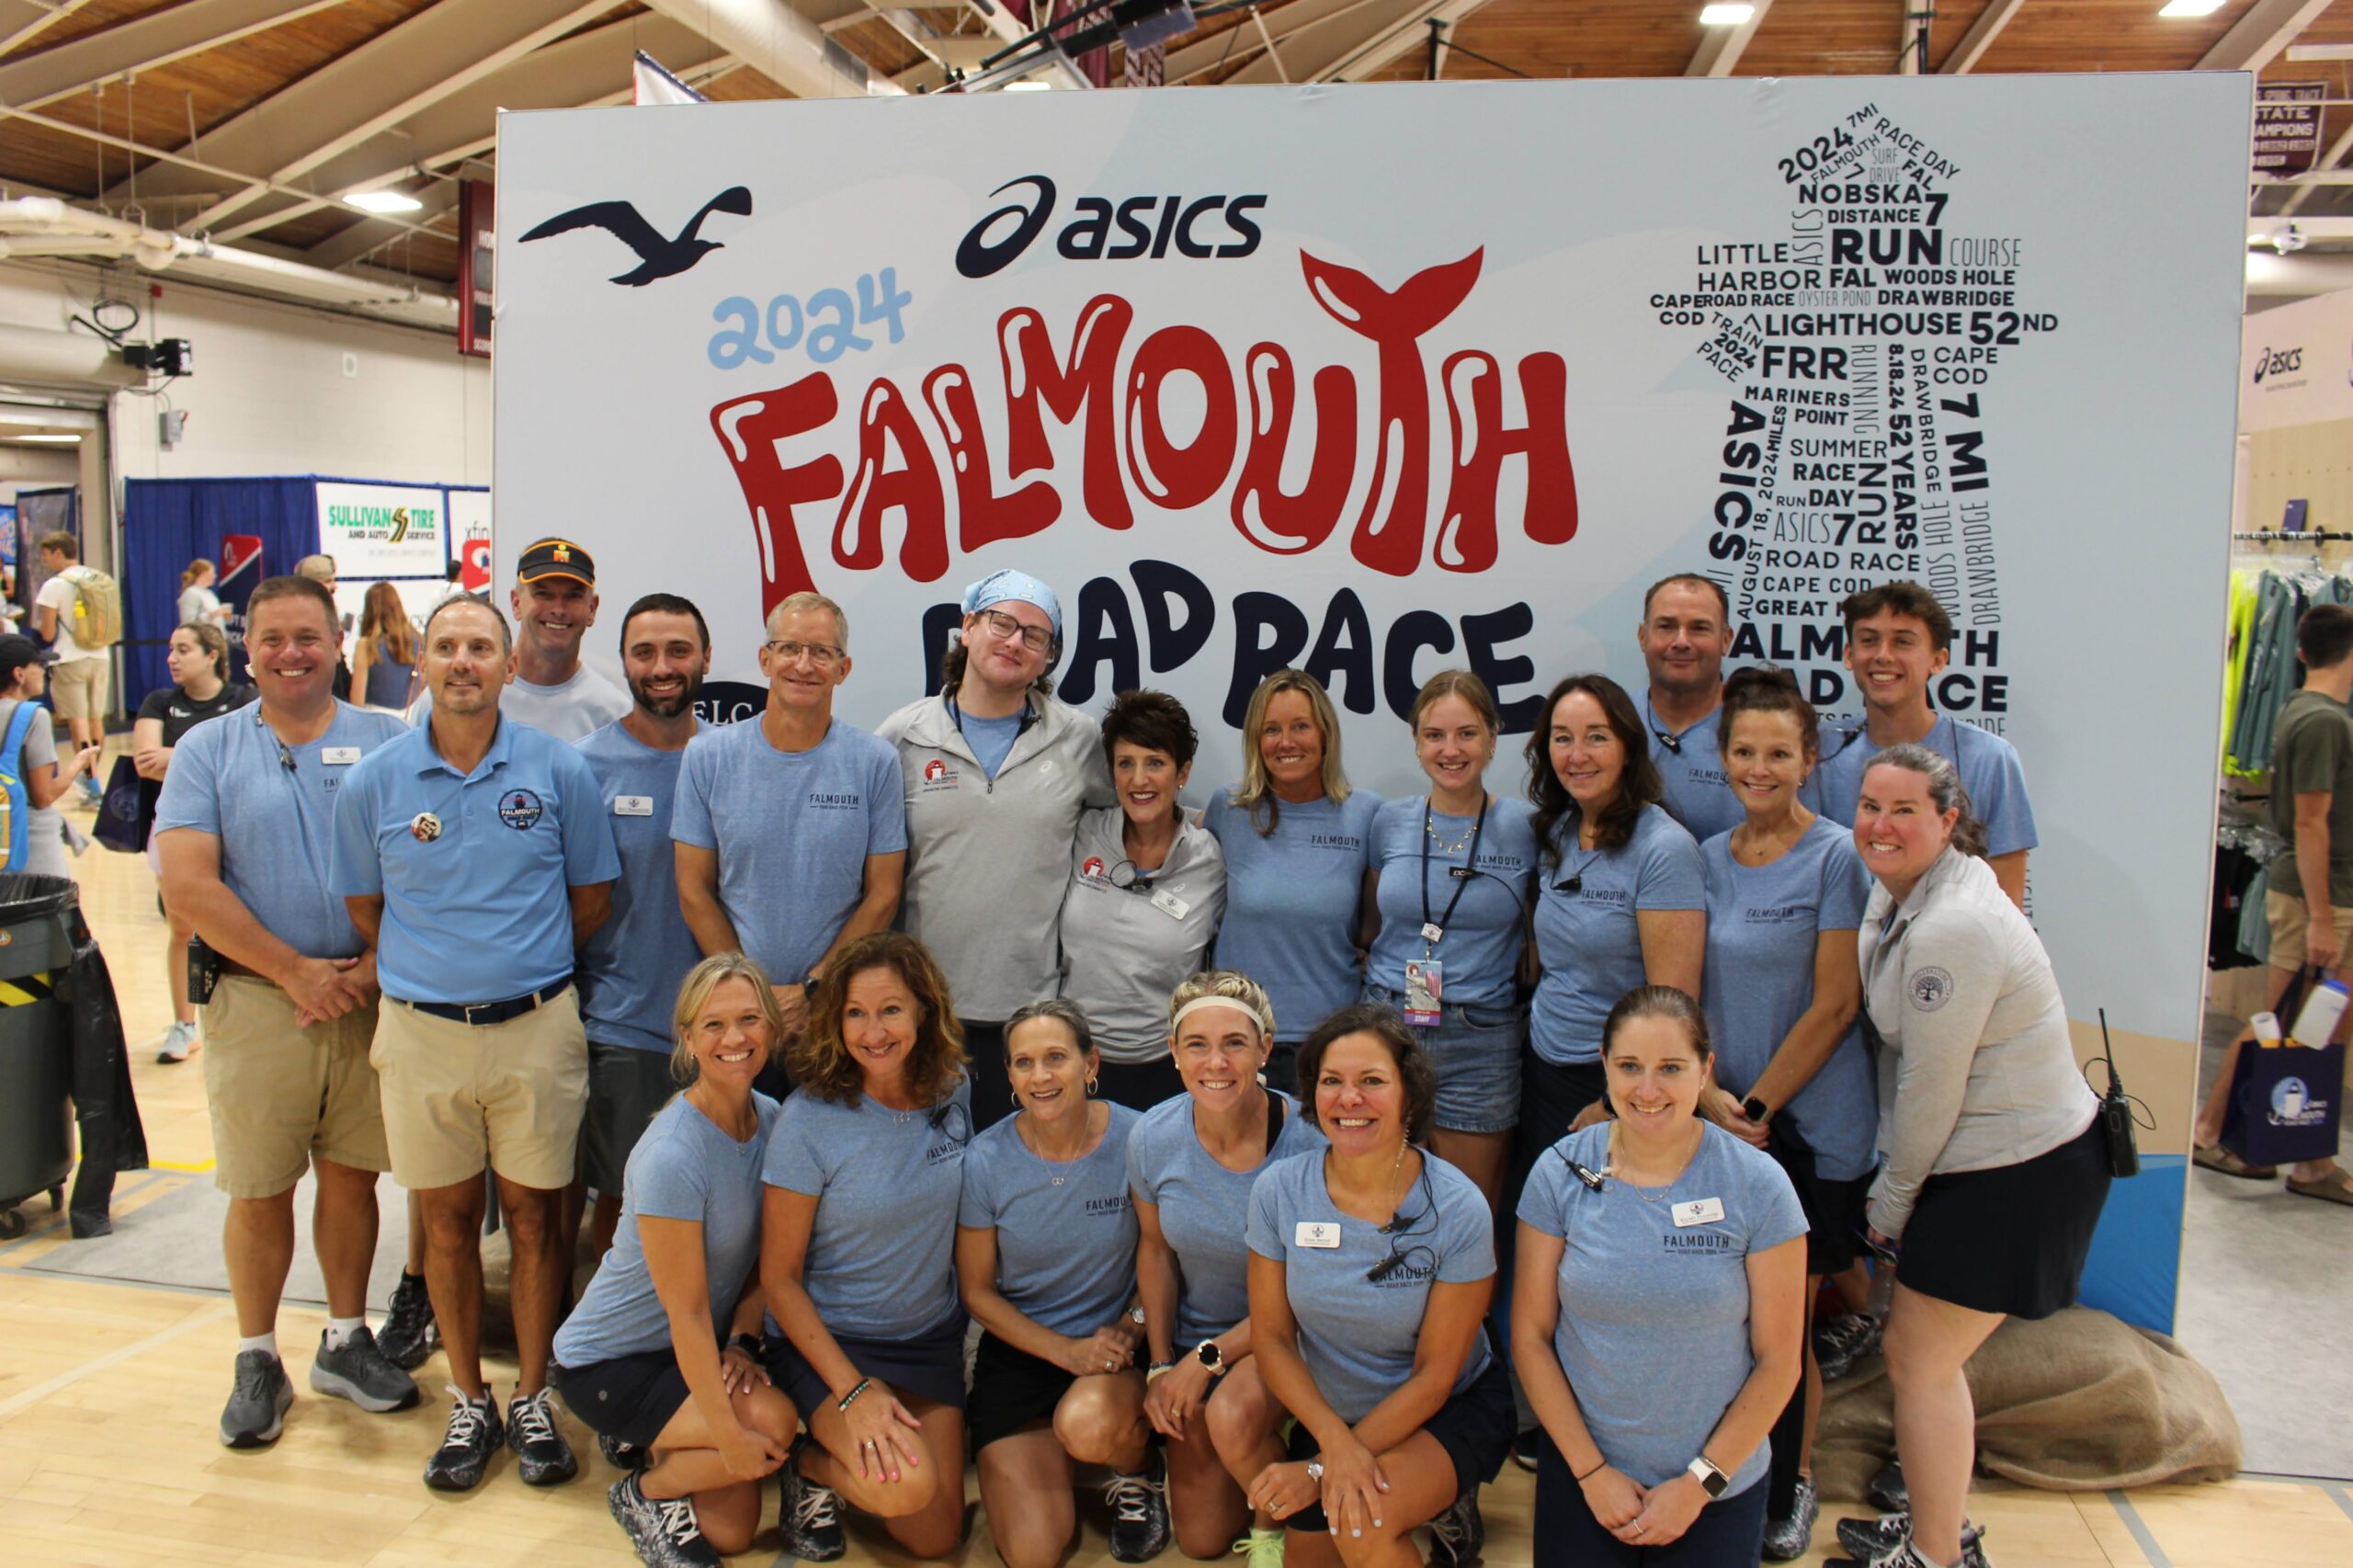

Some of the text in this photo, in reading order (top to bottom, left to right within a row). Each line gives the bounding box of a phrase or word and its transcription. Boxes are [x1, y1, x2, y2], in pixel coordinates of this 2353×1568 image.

[1847, 103, 1879, 128] 7MI
[2256, 122, 2314, 137] AMPIONS
[1778, 127, 1855, 184] 2024
[1810, 134, 1881, 184] FALMOUTH
[1872, 148, 1898, 165] SURF
[1874, 118, 1961, 179] RACE DAY
[1845, 163, 1865, 180] 7
[1870, 167, 1900, 183] DRIVE
[1902, 159, 1933, 191] FAL
[1799, 184, 1923, 204] NOBSKA
[1828, 209, 1920, 223] DISTANCE
[1925, 193, 1949, 226] 7
[1056, 195, 1267, 261] asics
[1791, 209, 1824, 267] ASICS
[1698, 243, 1789, 265] LITTLE
[1832, 229, 1942, 266] RUN
[1949, 238, 2021, 267] COURSE
[1699, 269, 1821, 292] HARBOR
[1830, 267, 1877, 288] FAL
[1884, 269, 2016, 286] WOODS HOLE
[1651, 294, 1704, 308] CAPE
[1703, 293, 1795, 307] ROAD RACE
[1799, 291, 1871, 306] OYSTER POND
[1878, 290, 2015, 306] DRAWBRIDGE
[707, 267, 912, 370] 2024
[1659, 311, 1704, 325] COD
[1766, 311, 2058, 345] LIGHTHOUSE 52ND
[1712, 312, 1764, 349] TRAIN
[1697, 339, 1744, 382] PACE
[1713, 332, 1756, 369] 2024
[1934, 347, 1997, 364] CAPE
[1762, 346, 1847, 381] FRR
[1889, 344, 1904, 409] 8.18.24
[1933, 368, 1988, 384] COD
[1745, 385, 1850, 407] MARINERS
[1851, 345, 1880, 434] RUNNING
[1794, 408, 1849, 426] POINT
[1911, 348, 1941, 493] DRAWBRIDGE
[710, 244, 1578, 628] FALMOUTH
[1767, 405, 1787, 452] MILES
[1889, 415, 1913, 448] 52
[1790, 438, 1887, 459] SUMMER
[1940, 392, 1989, 493] 7 MI
[1709, 400, 1768, 562] ASICS
[1793, 463, 1856, 482] RACE
[1776, 495, 1806, 507] RUN
[1809, 489, 1855, 507] DAY
[1858, 462, 1887, 544] RUN
[1892, 451, 1918, 551] YEARS
[328, 505, 436, 529] SULLIVAN TIRE
[1773, 512, 1830, 544] ASICS
[347, 530, 436, 540] AND AUTO SERVICE
[465, 520, 489, 540] xfin
[1737, 453, 1779, 620] AUGUST 18, 2024
[1833, 513, 1856, 546] 7
[1766, 550, 1920, 572] ROAD RACE
[1921, 501, 1961, 619] WOODS HOLE
[1960, 501, 2001, 625] DRAWBRIDGE
[1763, 576, 1820, 593] CAPE
[1829, 577, 1871, 593] COD
[1756, 599, 1828, 617] GREAT
[1222, 586, 1548, 735] RACE
[1688, 768, 1727, 780] FALMOU
[809, 793, 858, 805] FALMOUTH
[501, 808, 540, 817] FALMOUTH
[1311, 835, 1360, 846] FALMOUTH
[1475, 855, 1521, 867] ALMOUTH
[1581, 888, 1626, 901] FALMOUTH
[1086, 1197, 1132, 1210] FALMOU
[1664, 1235, 1729, 1248] FALMOUTH
[1381, 1267, 1431, 1281] ALMOUT
